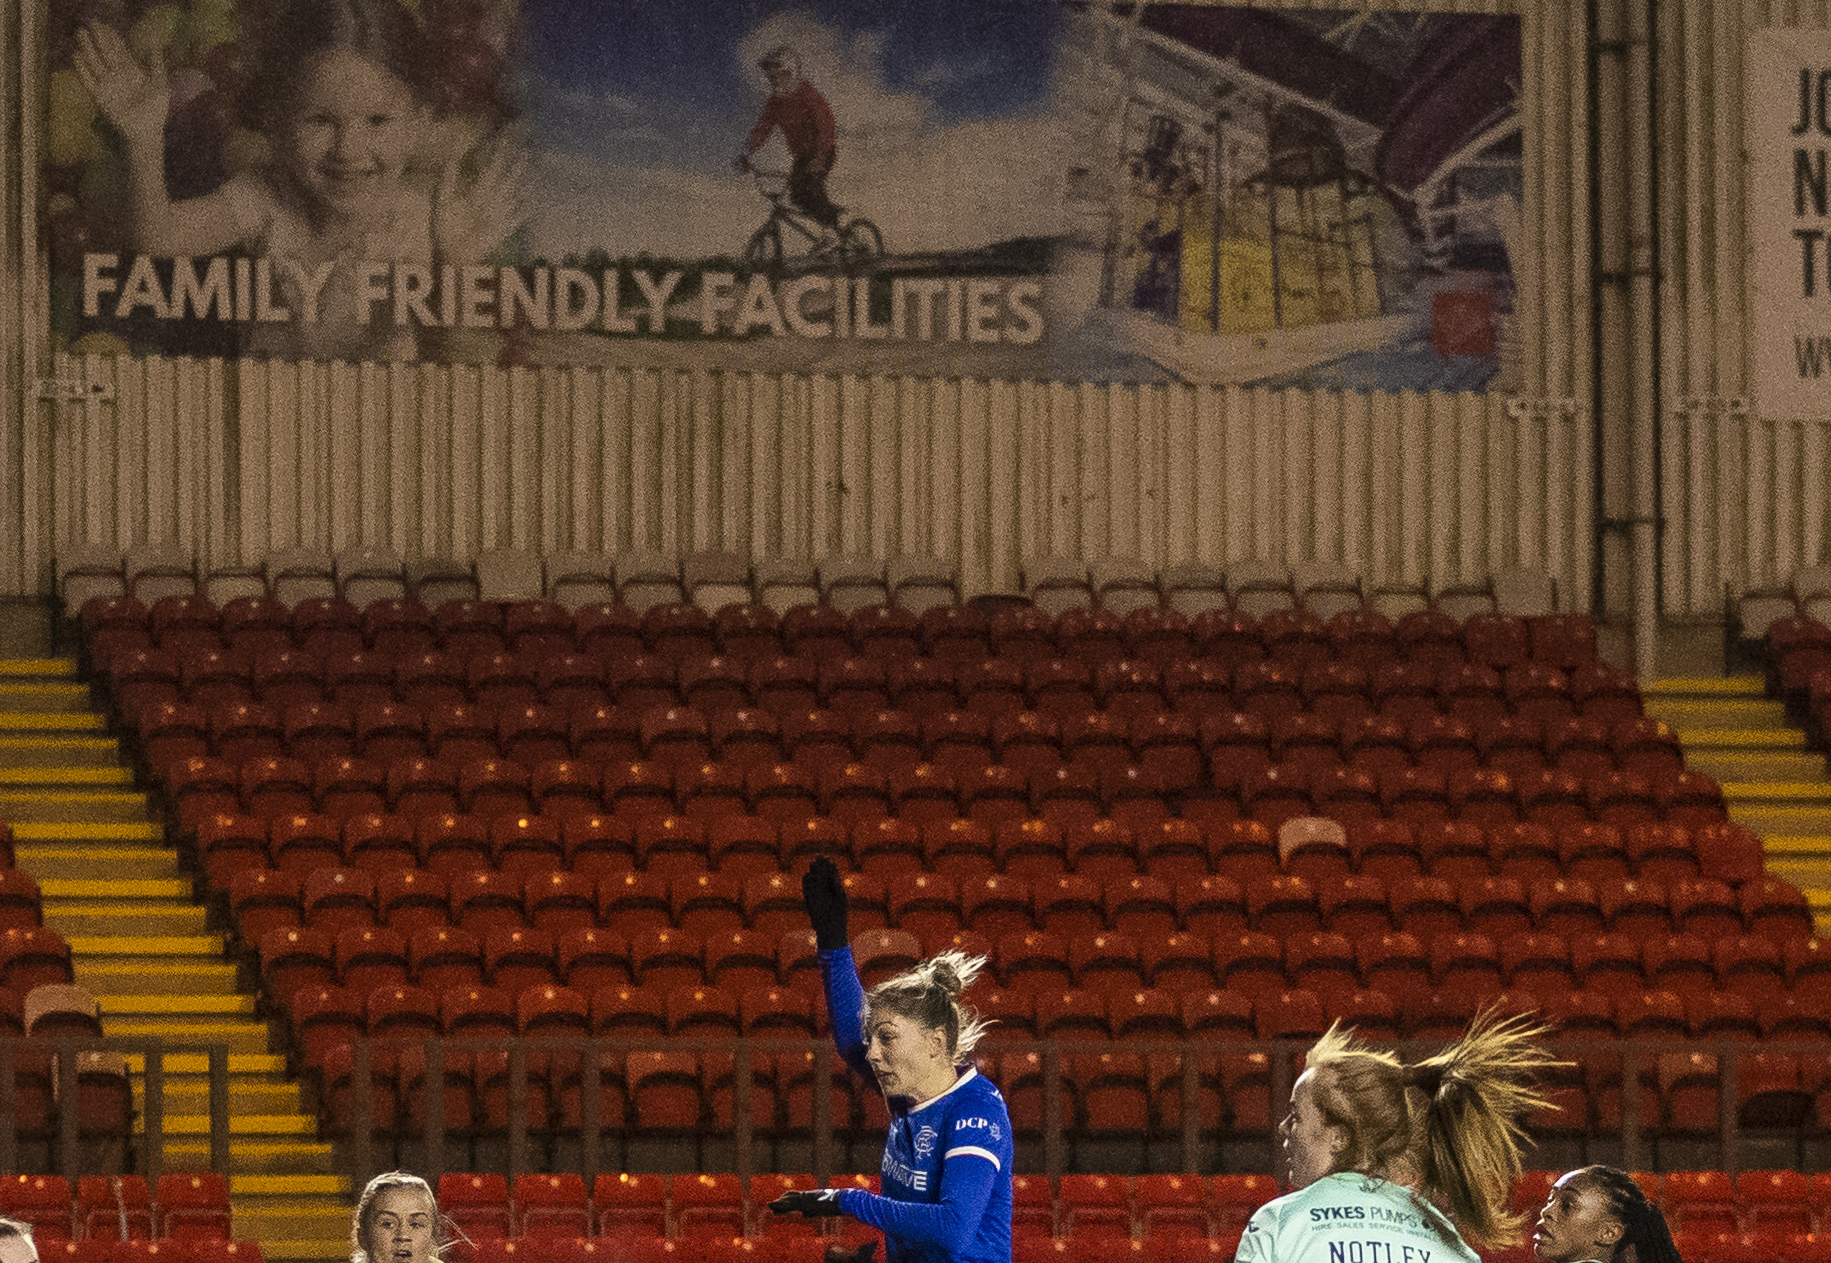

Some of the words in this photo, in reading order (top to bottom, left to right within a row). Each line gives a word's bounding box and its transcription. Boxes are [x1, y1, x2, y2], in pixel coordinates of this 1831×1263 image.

[82, 253, 335, 324] FAMILY
[355, 260, 683, 335] FRIENDLY
[699, 271, 1046, 344] FACILITIES
[955, 1117, 988, 1131] DCP
[1310, 1206, 1365, 1221] SYKES
[1370, 1206, 1418, 1228] PUMPS
